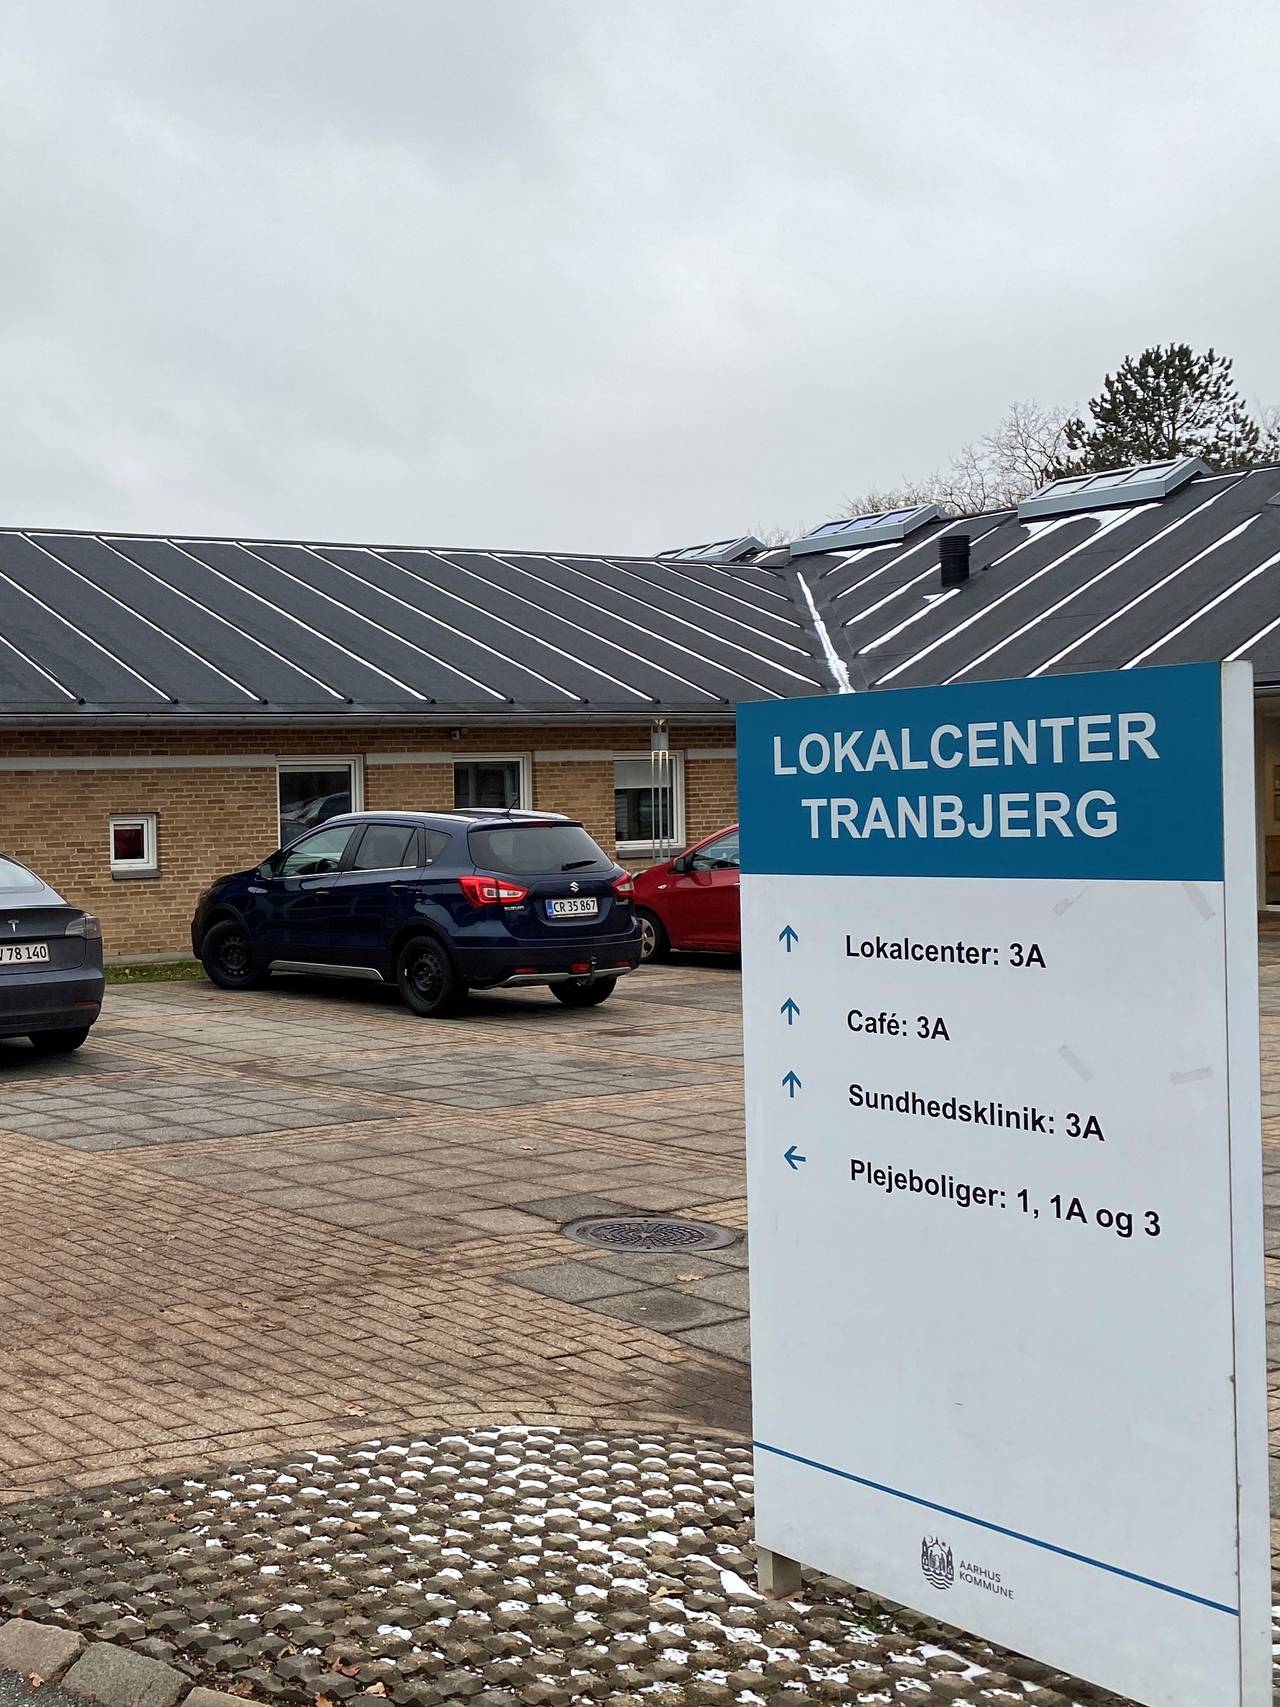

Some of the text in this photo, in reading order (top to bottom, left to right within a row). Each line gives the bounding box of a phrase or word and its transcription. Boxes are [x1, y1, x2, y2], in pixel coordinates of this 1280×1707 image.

[772, 711, 1160, 776] LOKALCENTER
[801, 789, 1118, 840] TRANBJERG
[553, 899, 596, 913] CR 35 867
[6, 947, 22, 960] 78
[25, 945, 47, 959] 140
[845, 934, 1047, 968] Lokalcenter: 3A
[847, 1009, 951, 1041] Café: 3A
[848, 1084, 1105, 1142] Sundhedsklinik: 3A
[850, 1159, 1161, 1238] Plejeboliger: 1, 1A og 3
[959, 1560, 1001, 1583] AARHUS
[959, 1571, 1015, 1600] KOMMUNE
